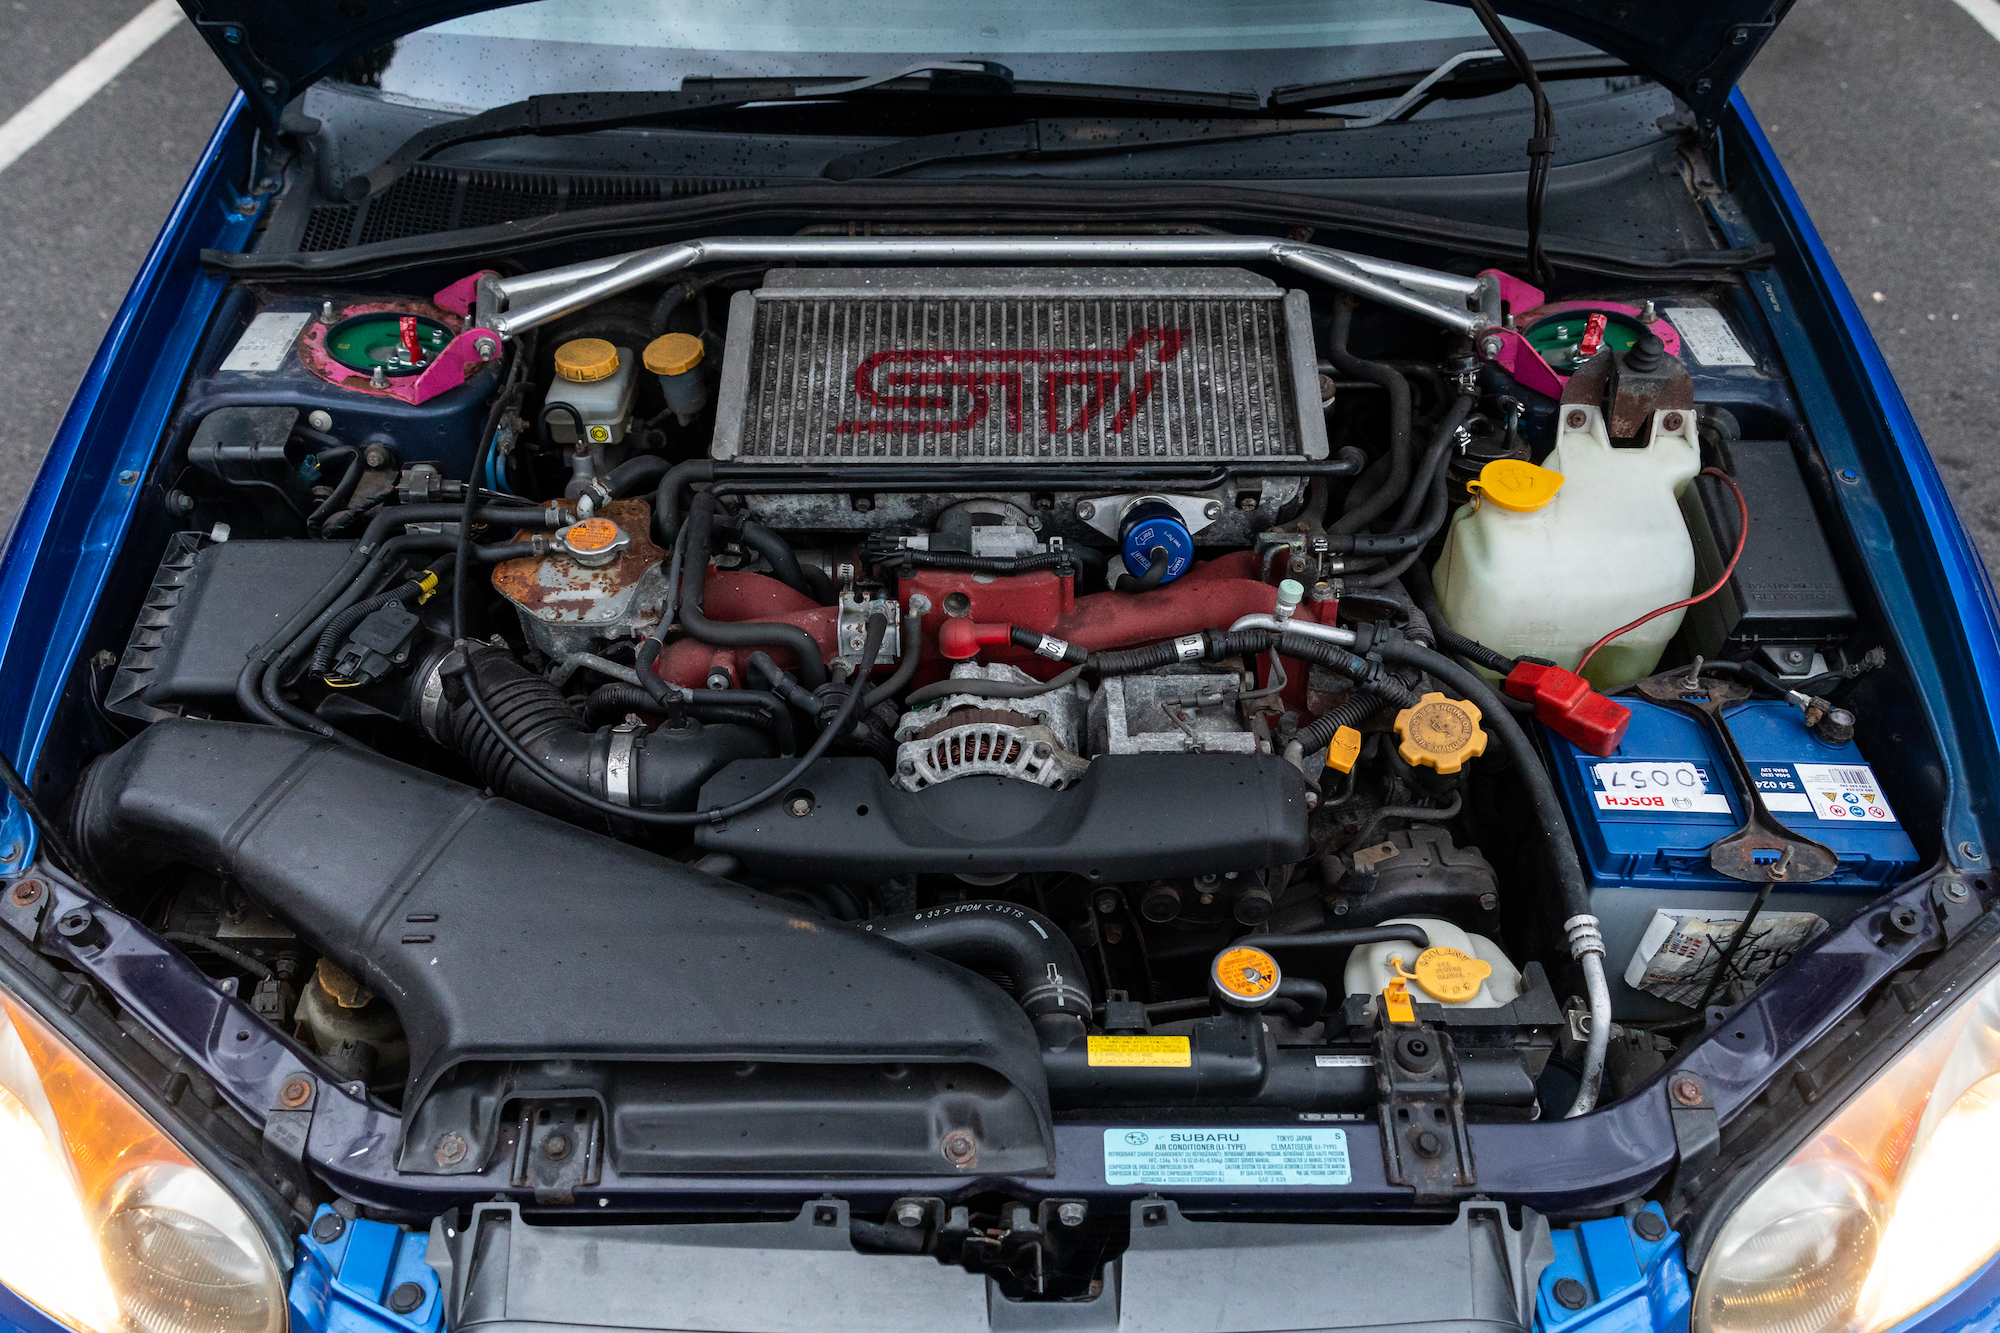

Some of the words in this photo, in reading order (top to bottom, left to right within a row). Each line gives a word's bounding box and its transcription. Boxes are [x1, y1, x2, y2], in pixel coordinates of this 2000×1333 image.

[1434, 704, 1466, 721] ENGINE
[1434, 737, 1468, 752] MANUAL
[1754, 780, 1778, 788] 024
[1779, 781, 1796, 789] S4
[1605, 795, 1665, 807] BOSCH
[926, 909, 940, 919] 33
[954, 904, 982, 913] EPDM
[1419, 949, 1470, 968] COOLANT
[1171, 1133, 1240, 1141] SUBARU
